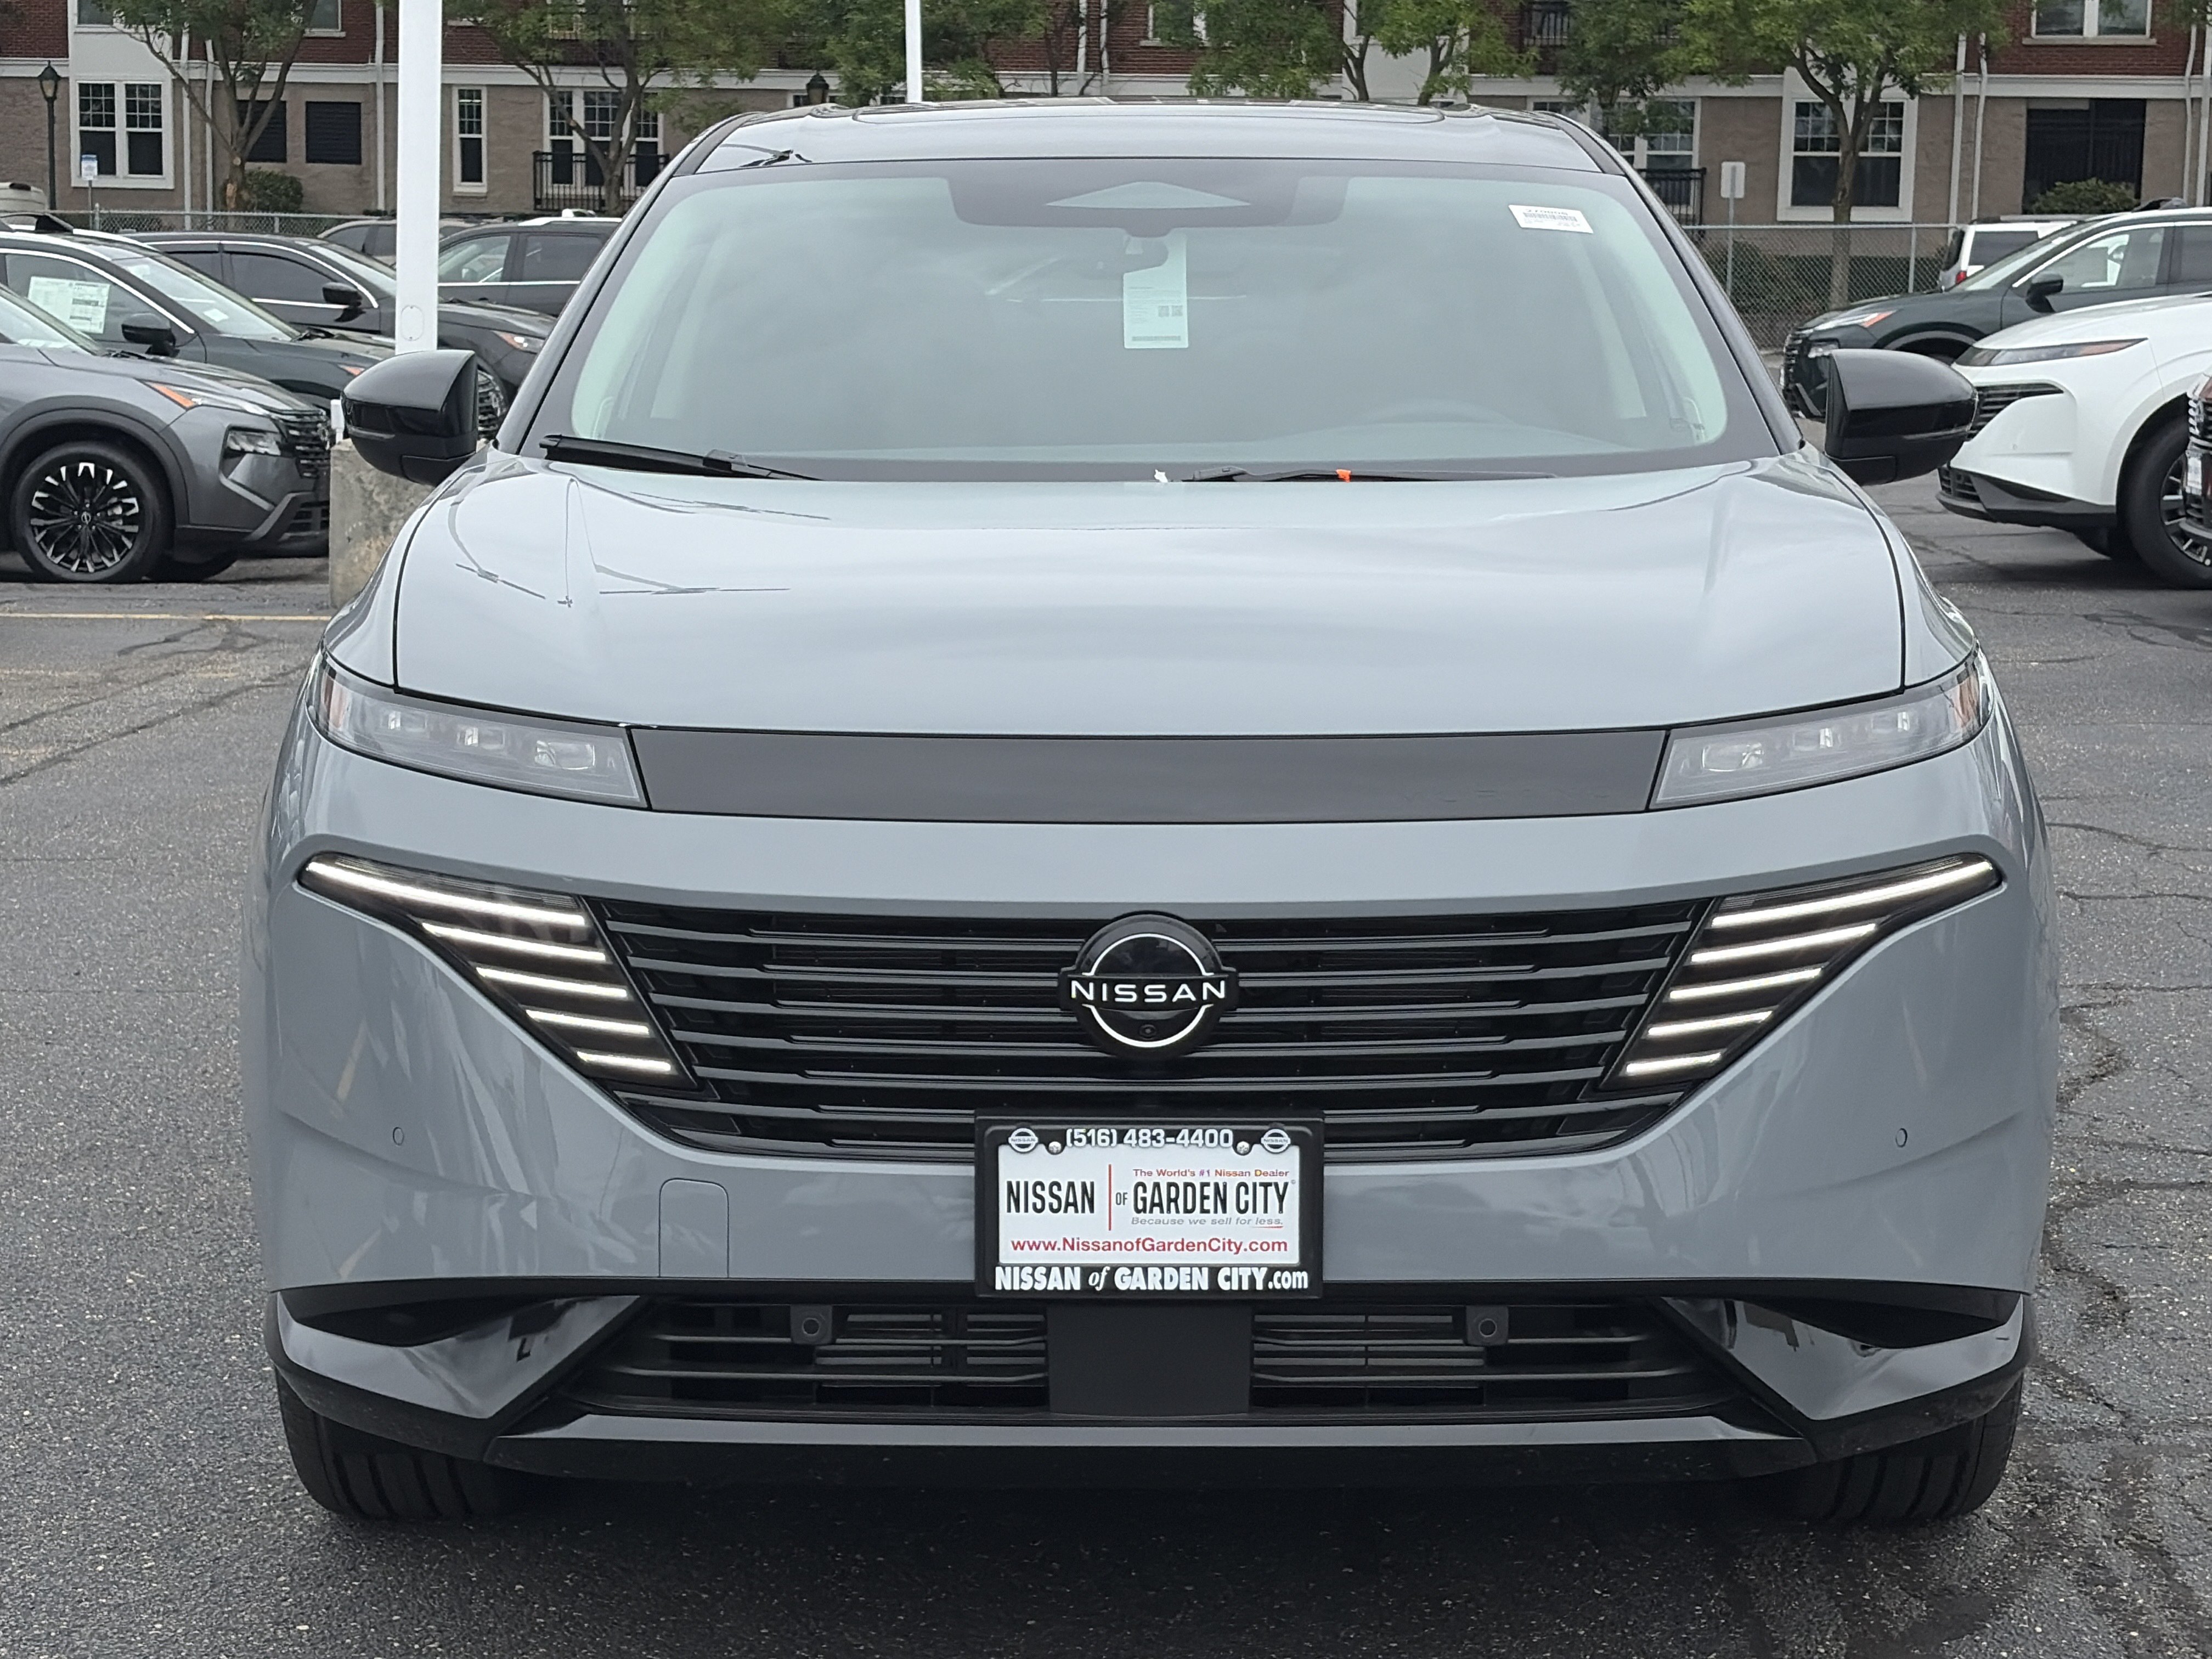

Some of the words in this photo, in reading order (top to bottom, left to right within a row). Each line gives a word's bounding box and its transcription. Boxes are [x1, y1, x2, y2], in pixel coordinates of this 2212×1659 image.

[1071, 980, 1225, 1002] NISSAN
[1066, 1128, 1118, 1147] (516)
[1123, 1128, 1233, 1148] 483-4400
[1133, 1169, 1153, 1177] The
[1156, 1169, 1196, 1177] World's
[1006, 1181, 1094, 1214] NISSAN
[1115, 1192, 1128, 1205] OF
[1133, 1181, 1227, 1214] GARDEN
[1235, 1181, 1289, 1214] CITY
[1131, 1217, 1184, 1225] Because
[1211, 1217, 1232, 1225] sell
[1235, 1217, 1252, 1225] for
[1255, 1217, 1284, 1225] less.
[1011, 1237, 1288, 1254] www.NissanofGardenCity.com
[995, 1267, 1081, 1290] NISSAN
[1088, 1266, 1111, 1290] of
[1114, 1267, 1209, 1290] GARDEN
